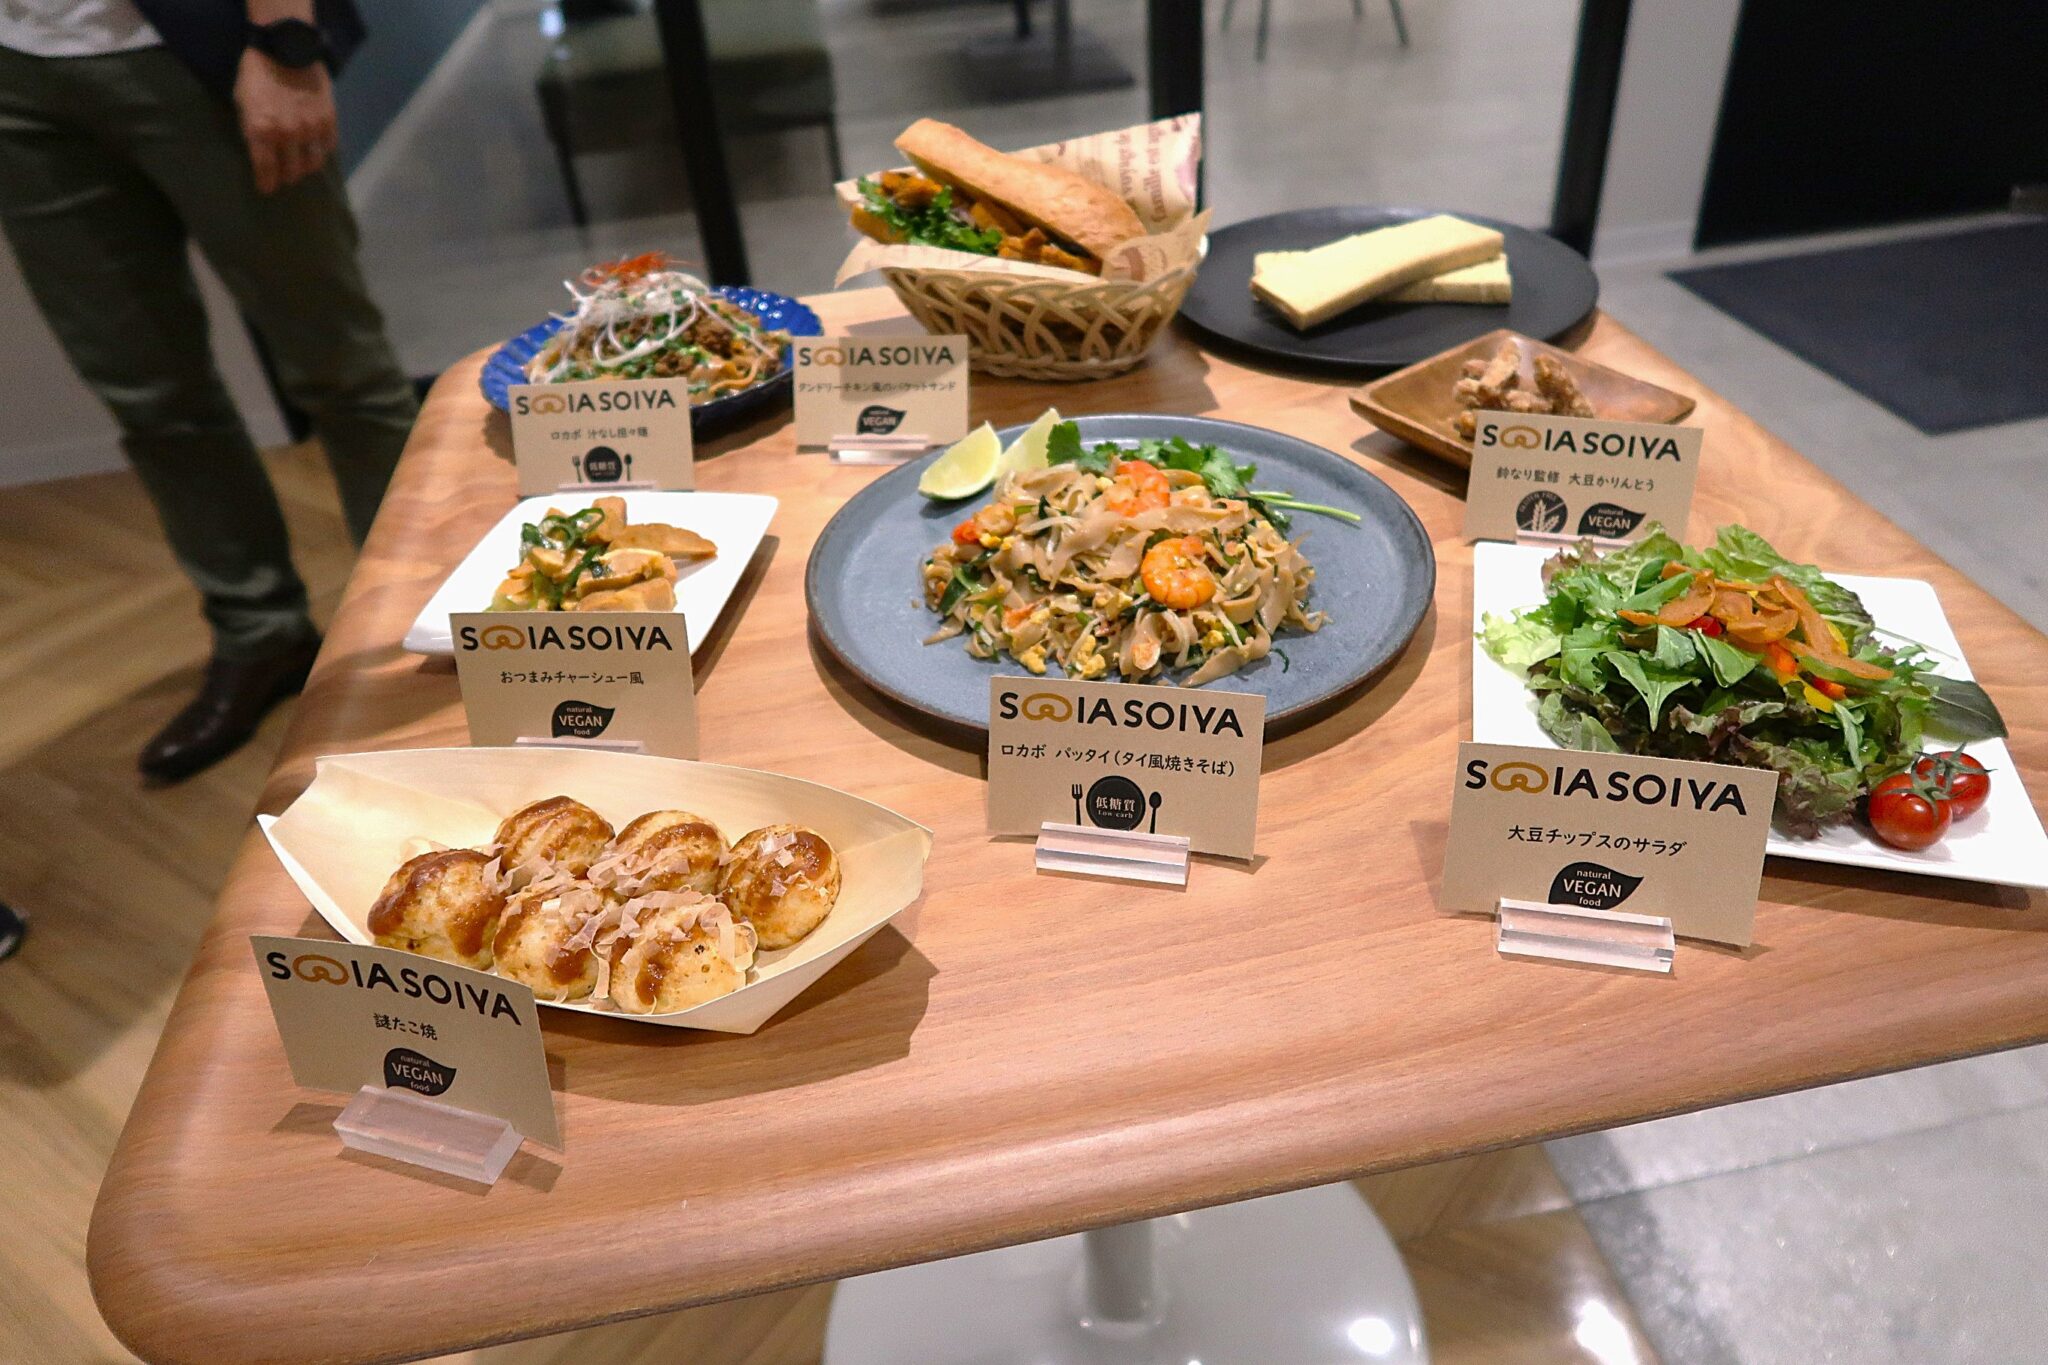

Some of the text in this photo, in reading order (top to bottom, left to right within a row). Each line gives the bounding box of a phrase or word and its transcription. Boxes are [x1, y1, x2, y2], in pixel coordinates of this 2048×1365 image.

[862, 416, 897, 426] VEGAN
[551, 429, 582, 440] ロカボ
[1568, 473, 1654, 492] 大豆かりんとう
[1588, 515, 1631, 529] VEGAN
[500, 671, 644, 685] おつまみチャーシュー風
[558, 715, 603, 727] VEGAN
[574, 728, 590, 736] food
[1001, 744, 1047, 758] ロカボ
[1096, 796, 1136, 813] 低糖質
[1507, 825, 1687, 856] 大豆チップスのサラダ
[1576, 869, 1611, 880] natural
[1563, 879, 1622, 898] VEGAN
[1579, 896, 1601, 907] food
[373, 1013, 438, 1040] 謎たこ焼
[400, 1056, 430, 1067] natural
[391, 1062, 444, 1086] VEGAN
[410, 1081, 430, 1092] food
